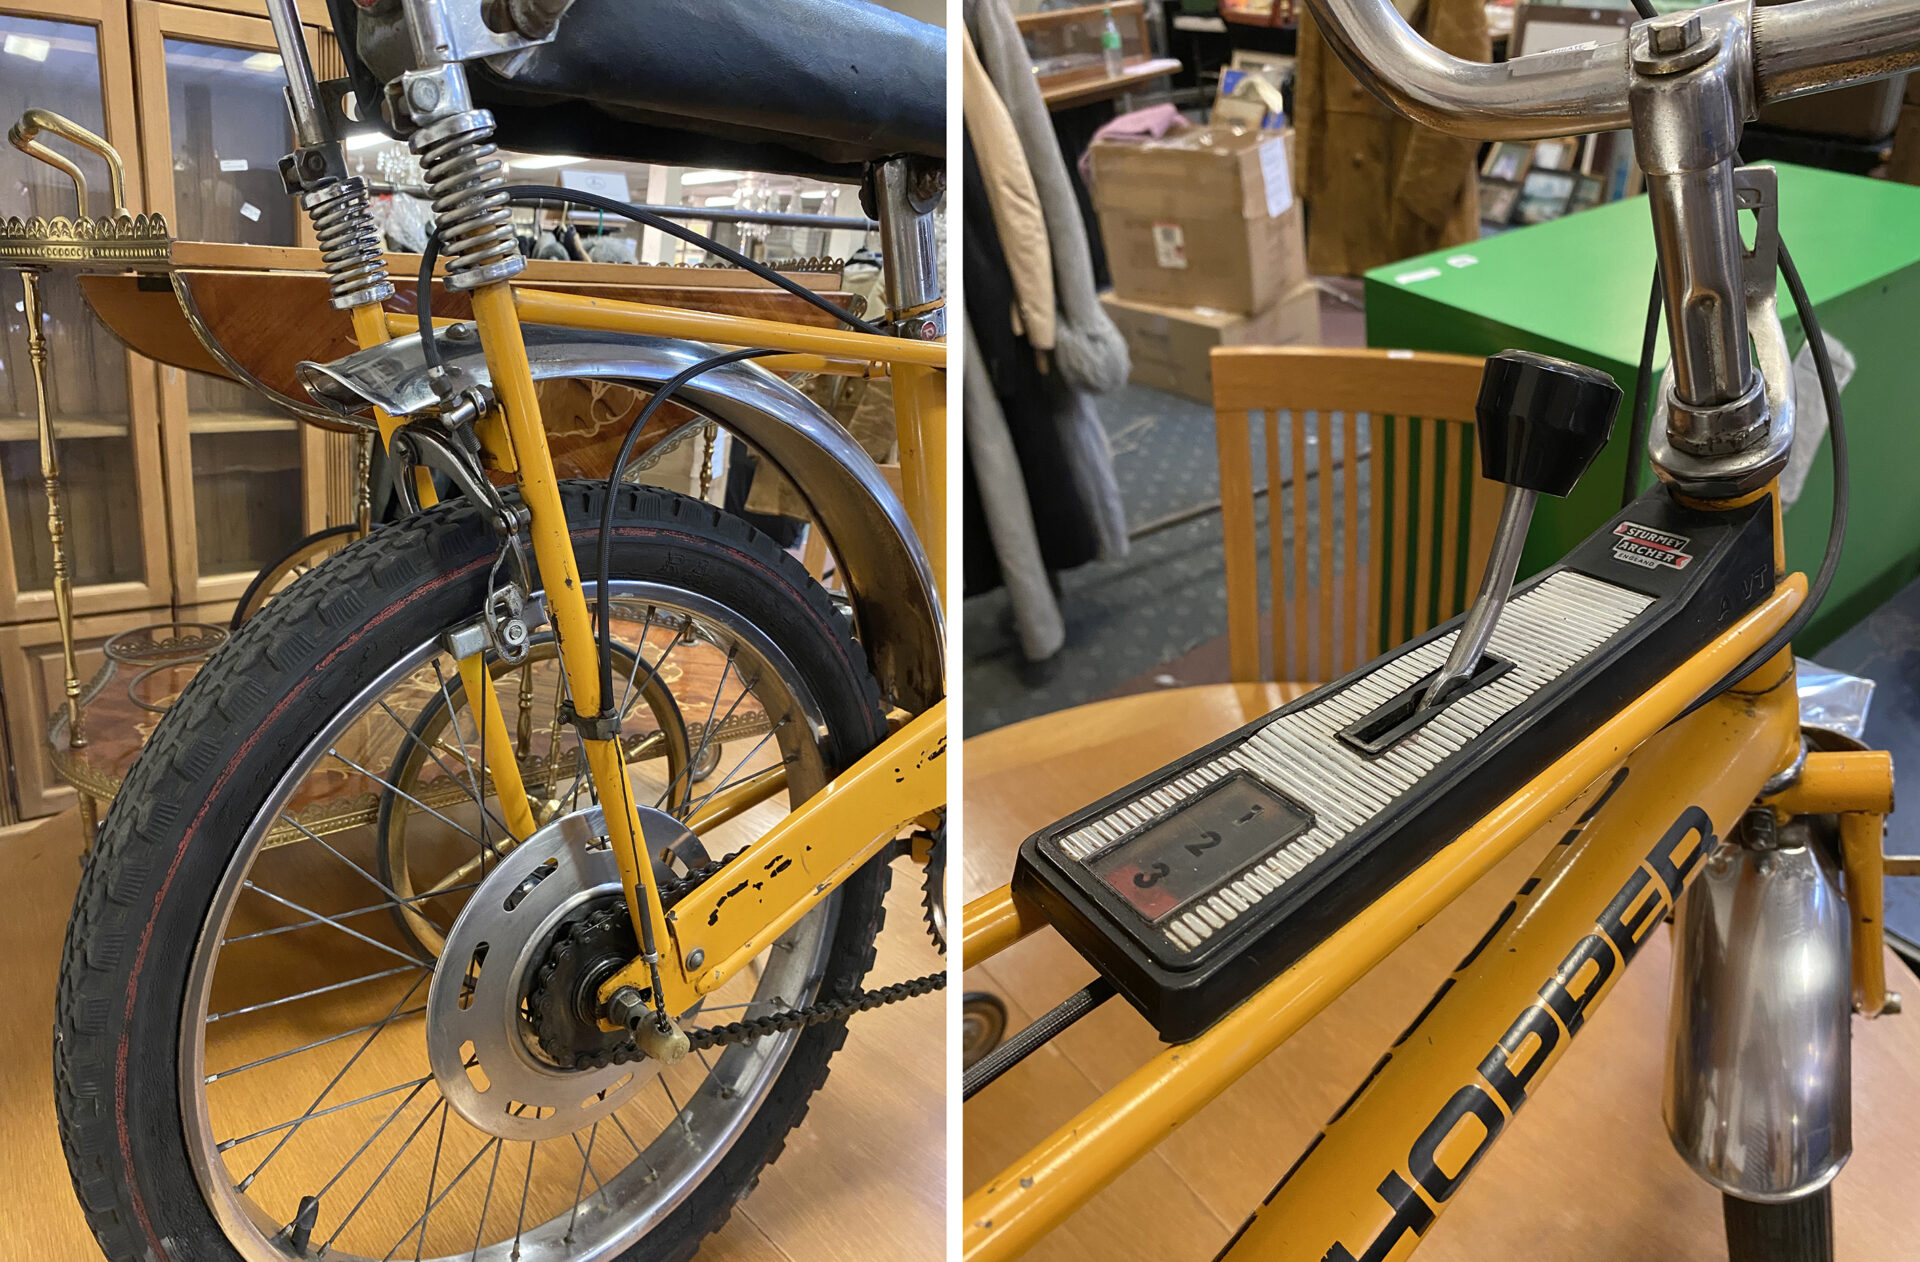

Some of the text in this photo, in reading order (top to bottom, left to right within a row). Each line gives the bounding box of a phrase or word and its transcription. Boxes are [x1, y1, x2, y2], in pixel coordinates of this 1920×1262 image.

[1627, 526, 1683, 548] STURMEY
[1618, 541, 1678, 563] ARCHER
[1618, 552, 1655, 567] ENGLAND
[1184, 830, 1222, 857] 2
[1133, 862, 1170, 889] 3
